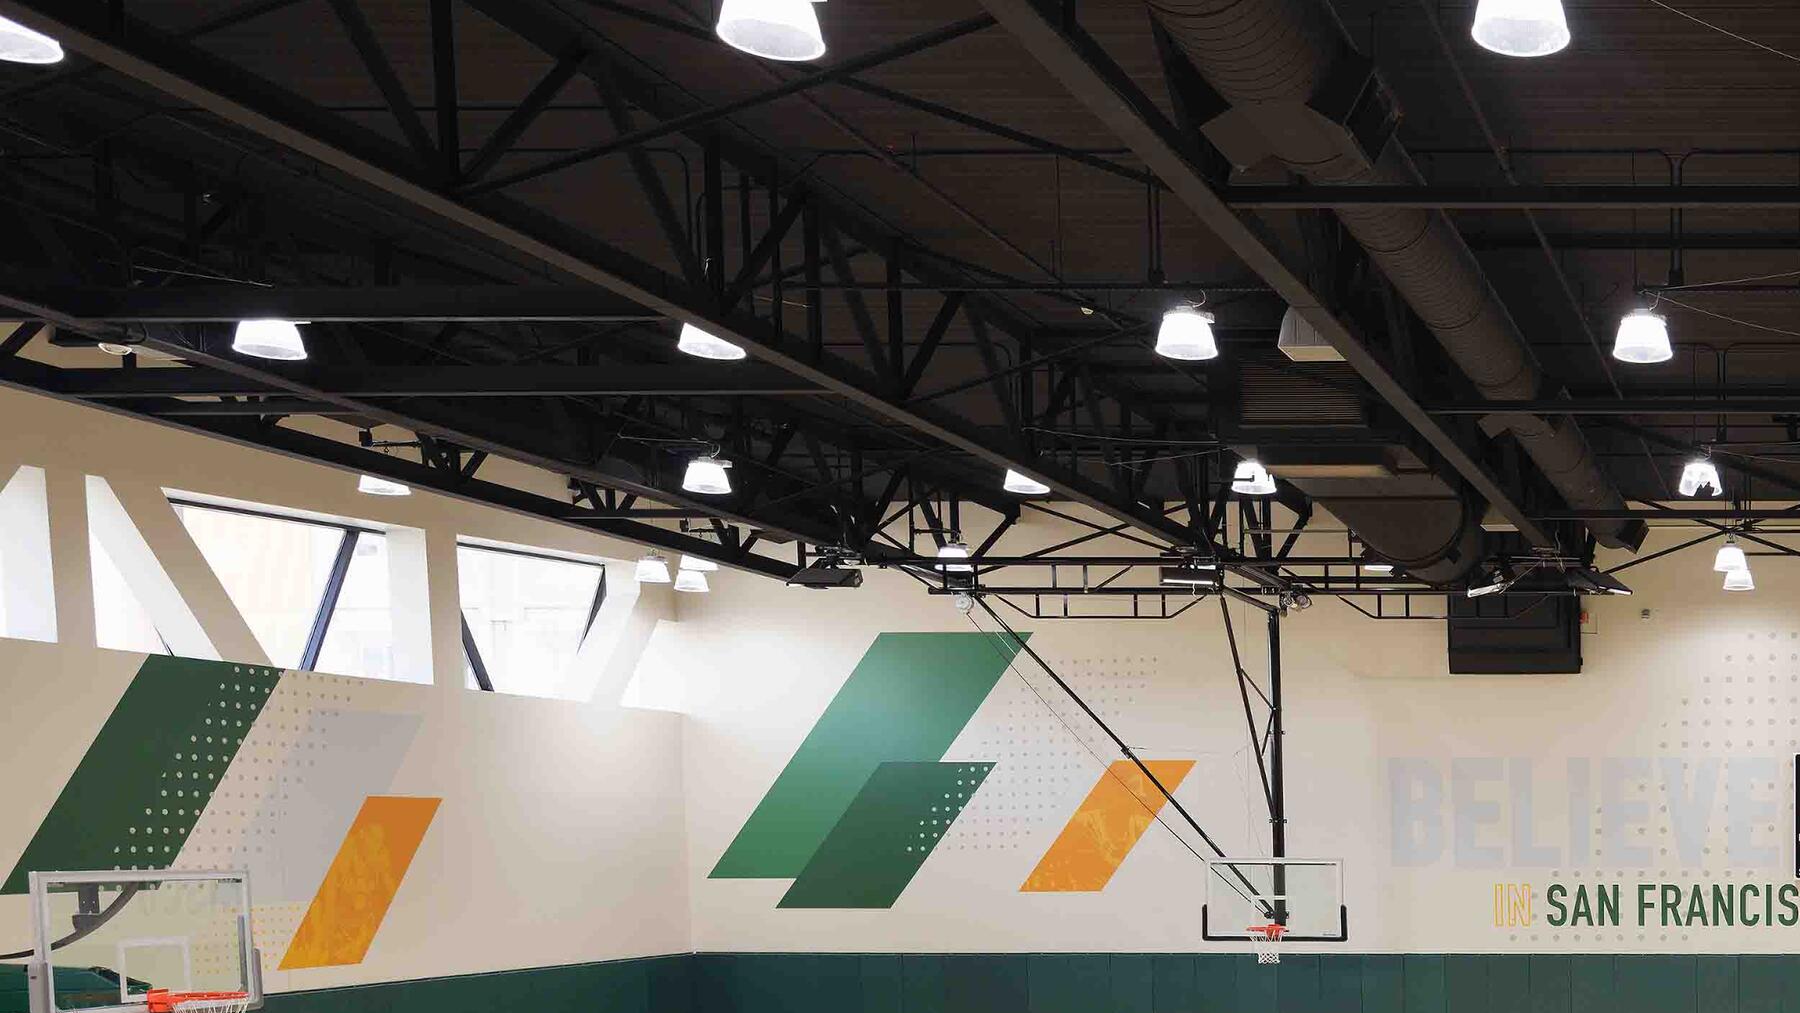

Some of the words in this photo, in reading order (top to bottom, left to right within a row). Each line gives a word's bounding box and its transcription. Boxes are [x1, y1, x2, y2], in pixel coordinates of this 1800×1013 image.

[1388, 756, 1783, 869] BELIEVE
[1494, 884, 1532, 927] IN
[1546, 883, 1620, 927] SAN
